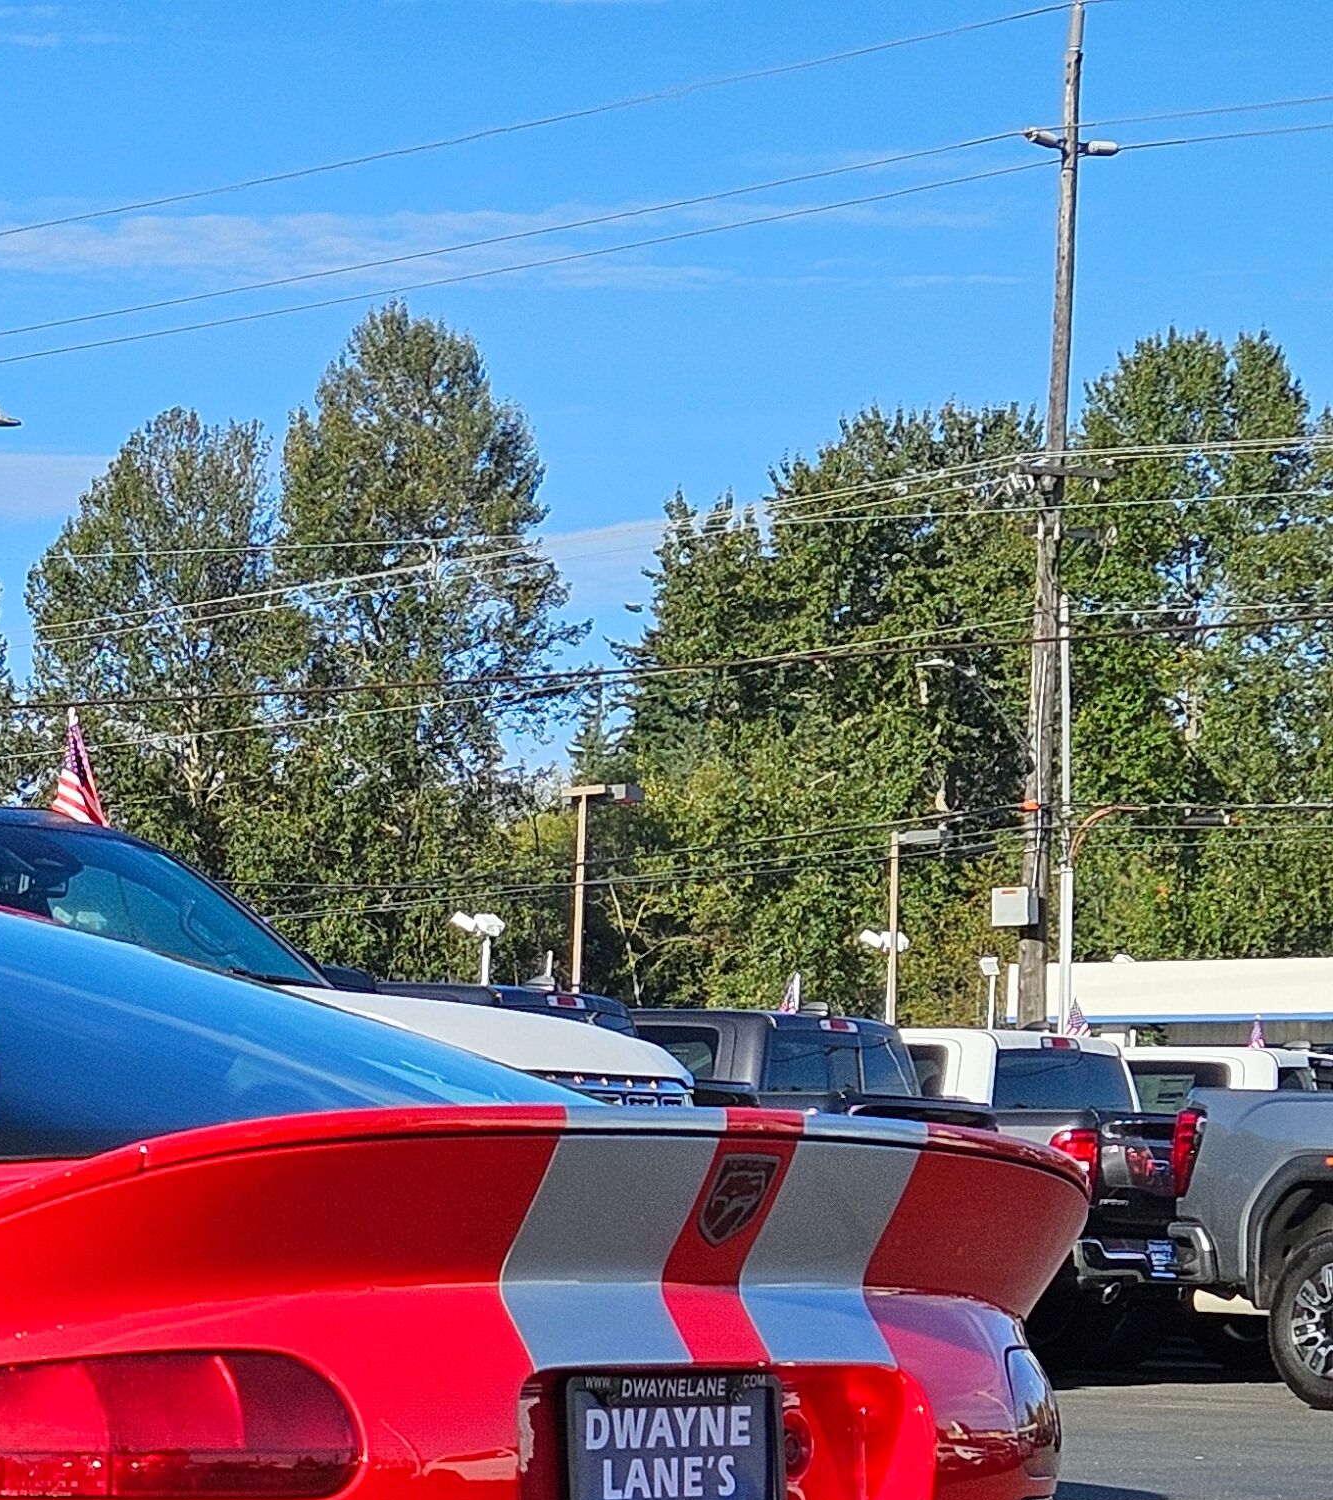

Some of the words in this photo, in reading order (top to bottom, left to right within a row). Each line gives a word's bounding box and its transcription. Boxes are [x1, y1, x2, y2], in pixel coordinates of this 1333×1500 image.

[621, 1377, 727, 1398] DWAYNELANE
[585, 1405, 752, 1451] DWAYNE
[602, 1454, 737, 1500] LANE'S
